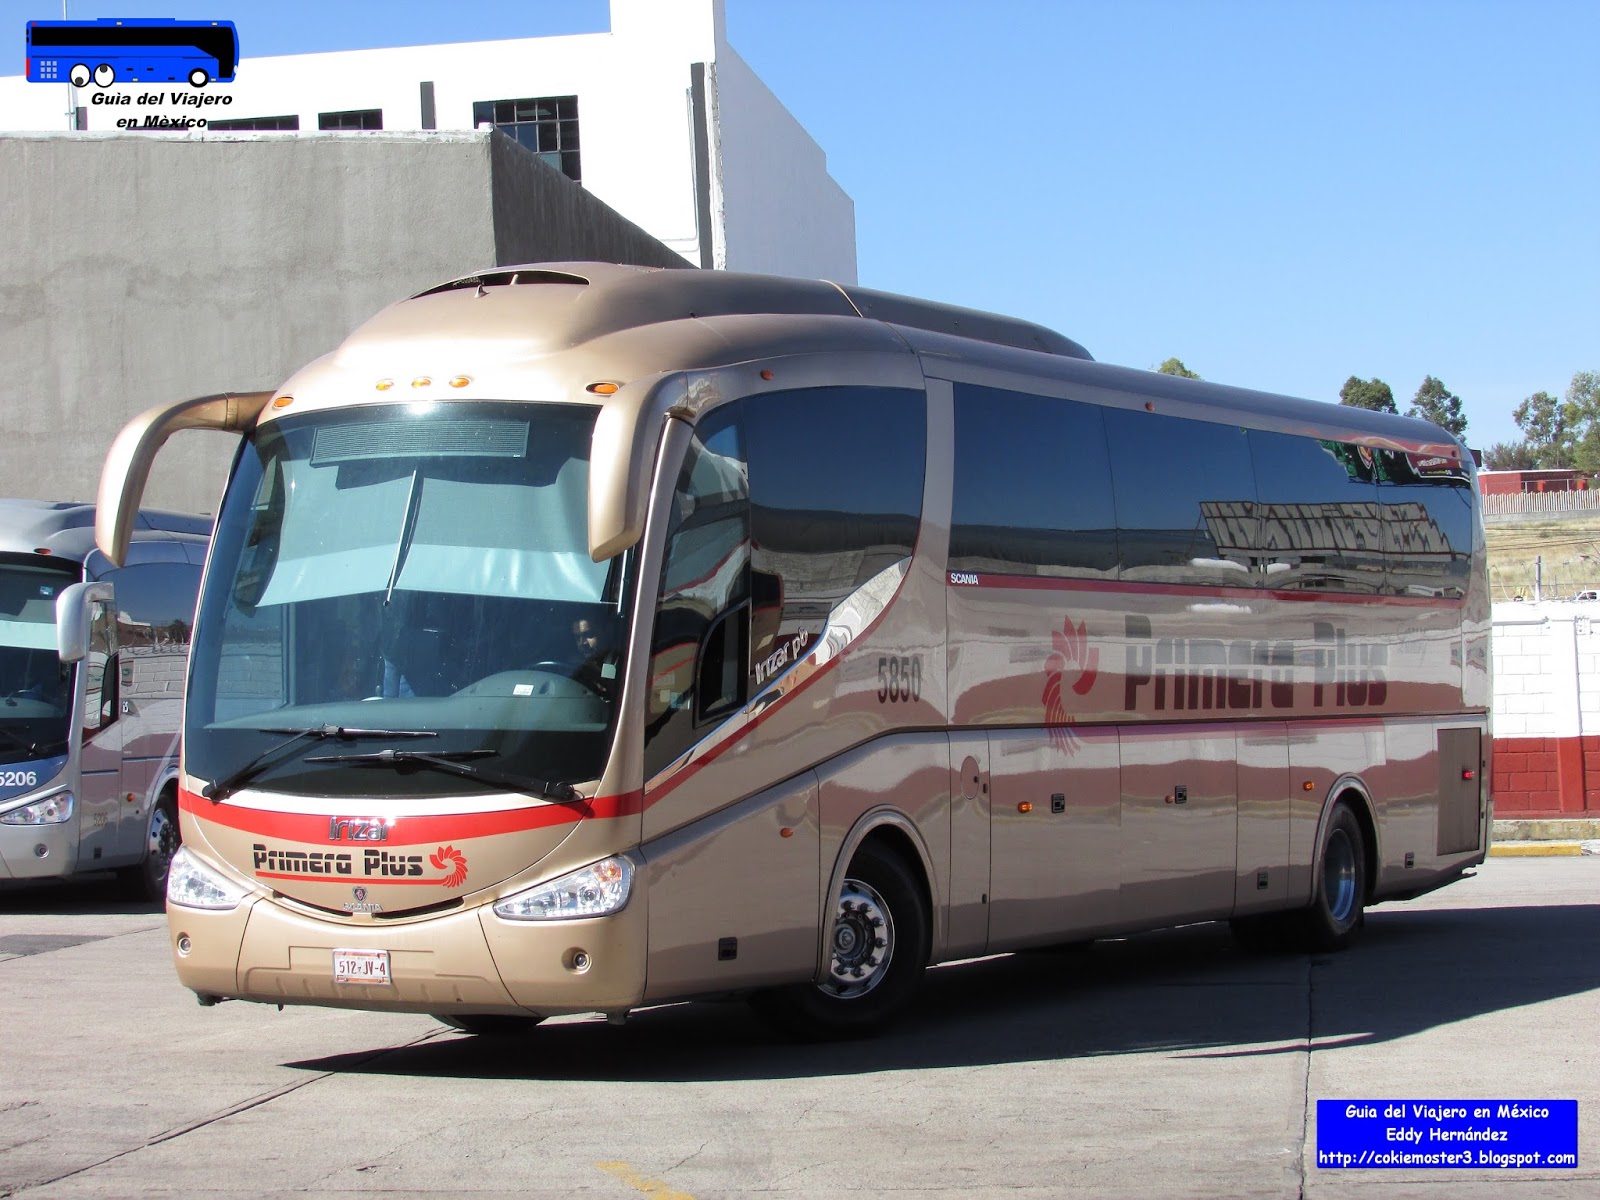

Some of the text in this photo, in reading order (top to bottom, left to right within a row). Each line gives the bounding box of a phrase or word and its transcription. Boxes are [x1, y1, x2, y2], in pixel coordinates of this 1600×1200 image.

[950, 572, 979, 585] SCANIA
[1124, 614, 1388, 711] Primera Plus
[877, 656, 922, 704] 5850
[328, 815, 394, 841] Irizar
[253, 843, 423, 877] Primera Plus
